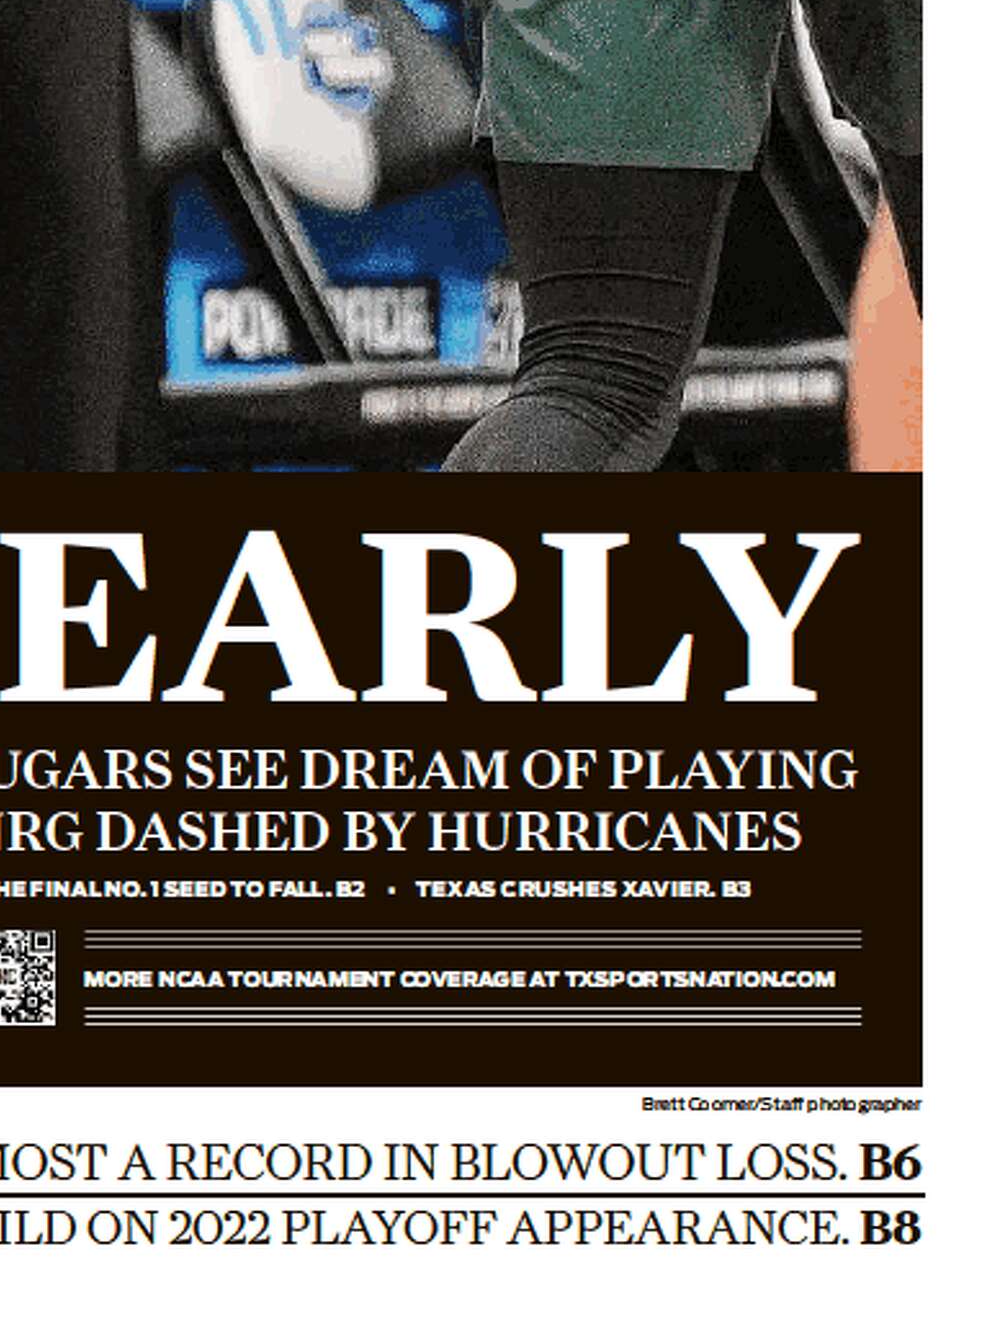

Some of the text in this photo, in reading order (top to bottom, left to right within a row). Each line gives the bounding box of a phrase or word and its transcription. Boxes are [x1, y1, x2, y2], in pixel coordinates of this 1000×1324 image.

[0, 531, 861, 704] EARLY
[186, 750, 288, 790] SEE
[301, 750, 509, 790] DREAM
[522, 750, 597, 790] OF
[610, 750, 858, 790] PLAYING
[96, 811, 329, 851] DASHED
[344, 811, 416, 851] BY
[429, 811, 802, 851] HURRICANES
[30, 880, 102, 898] FINAL
[104, 880, 148, 898] NO.
[150, 880, 159, 898] 1
[163, 880, 226, 898] SEED
[230, 880, 264, 898] TO
[269, 880, 332, 898] FALL.
[336, 880, 365, 898] B2
[415, 880, 751, 898] TEXAS CRUSHES XAVIER. B3
[84, 970, 836, 988] MORE NCAA TOURNAMENT COVERAGE AT TXSPORTSNATION.COM
[118, 1143, 156, 1180] A
[168, 1143, 372, 1180] RECORD
[384, 1143, 438, 1180] IN
[451, 1143, 705, 1180] BLOWOUT
[717, 1143, 846, 1180] LOSS.
[859, 1143, 922, 1180] B6
[87, 1210, 158, 1245] ON
[170, 1210, 271, 1245] 2022
[282, 1210, 497, 1245] PLAYOFF
[506, 1210, 848, 1245] APPEARANCE.
[861, 1210, 921, 1245] B8
